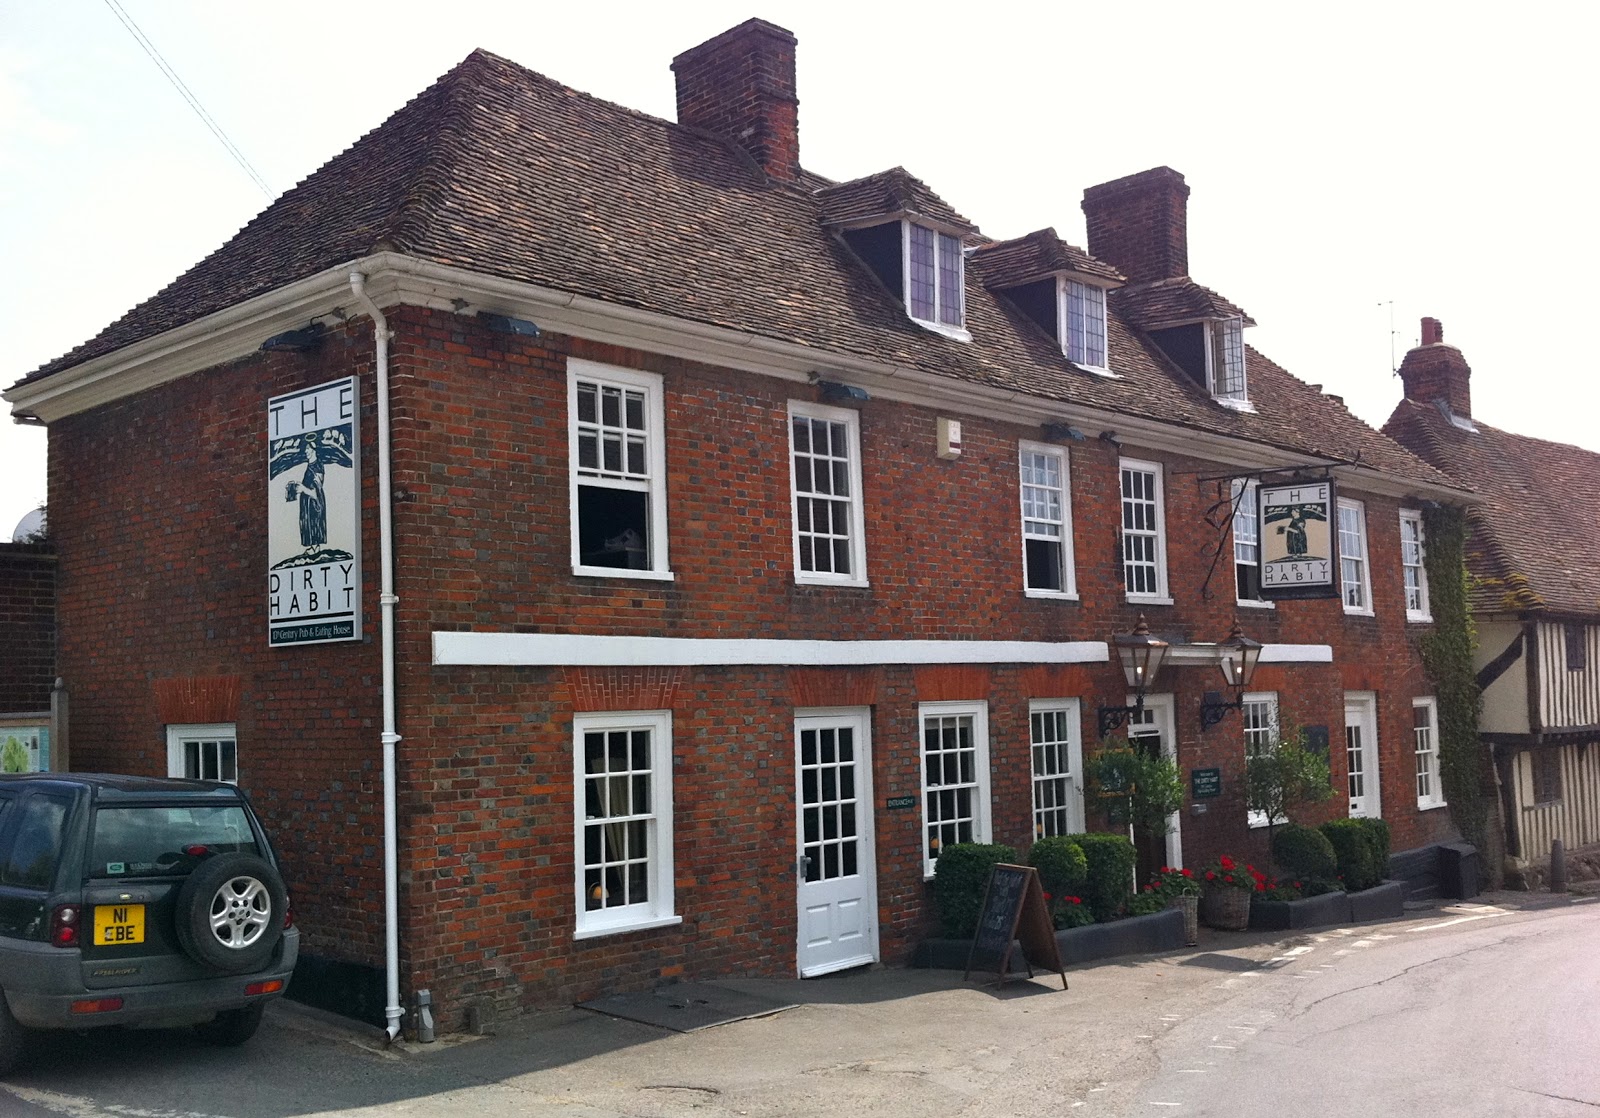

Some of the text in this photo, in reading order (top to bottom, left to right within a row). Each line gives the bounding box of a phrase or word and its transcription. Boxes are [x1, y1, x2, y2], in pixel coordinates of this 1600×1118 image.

[270, 387, 353, 436] THE
[1264, 488, 1327, 504] THE
[1264, 561, 1328, 574] DIRTY
[270, 563, 353, 594] DIRTY
[1265, 571, 1328, 582] HABIT
[270, 587, 354, 617] HABIT
[280, 629, 299, 640] Century
[299, 627, 309, 638] Pub
[309, 627, 315, 637] &
[315, 625, 333, 638] Eating
